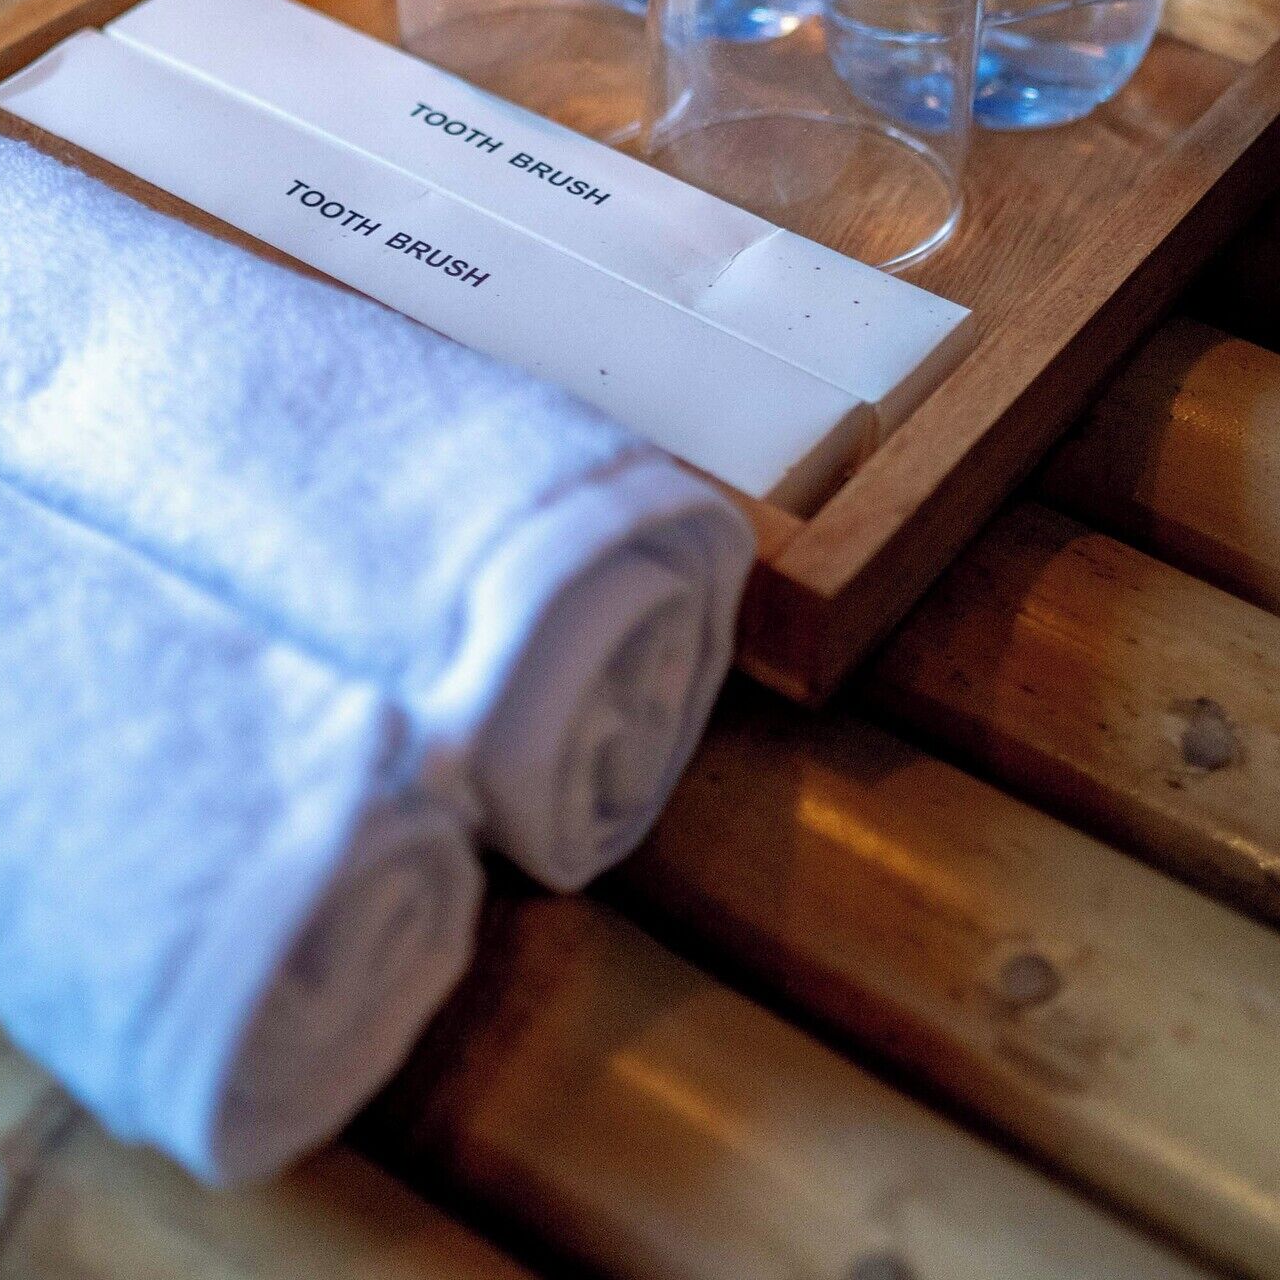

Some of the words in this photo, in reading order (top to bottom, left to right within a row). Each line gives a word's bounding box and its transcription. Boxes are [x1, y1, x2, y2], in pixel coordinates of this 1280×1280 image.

[410, 102, 504, 154] TOOTH
[507, 151, 612, 207] BRUSH
[285, 178, 383, 237] TOOTH
[384, 231, 492, 289] BRUSH
